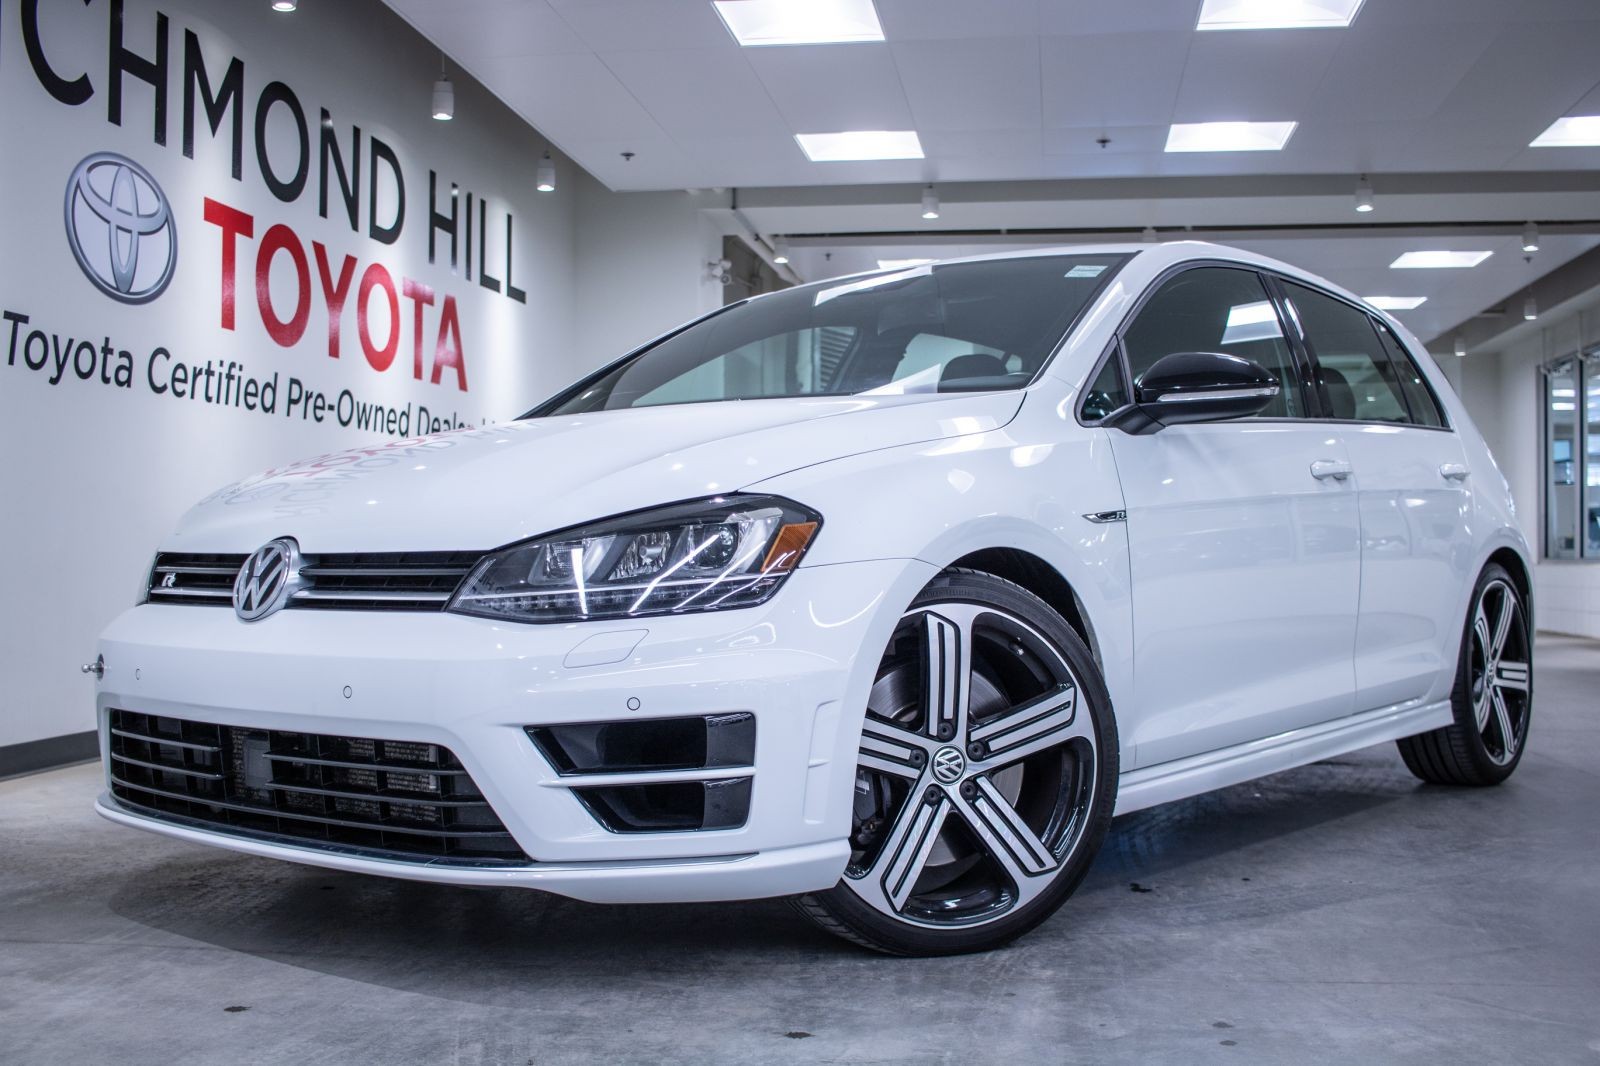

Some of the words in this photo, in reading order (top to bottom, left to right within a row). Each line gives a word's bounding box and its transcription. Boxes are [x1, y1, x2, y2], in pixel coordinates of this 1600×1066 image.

[20, 0, 405, 245] CHMOND
[428, 169, 526, 304] HILL
[2, 310, 134, 386] Toyota
[147, 347, 279, 414] Certified
[286, 377, 411, 438] Pre-Owned
[203, 196, 468, 392] TOYOTA
